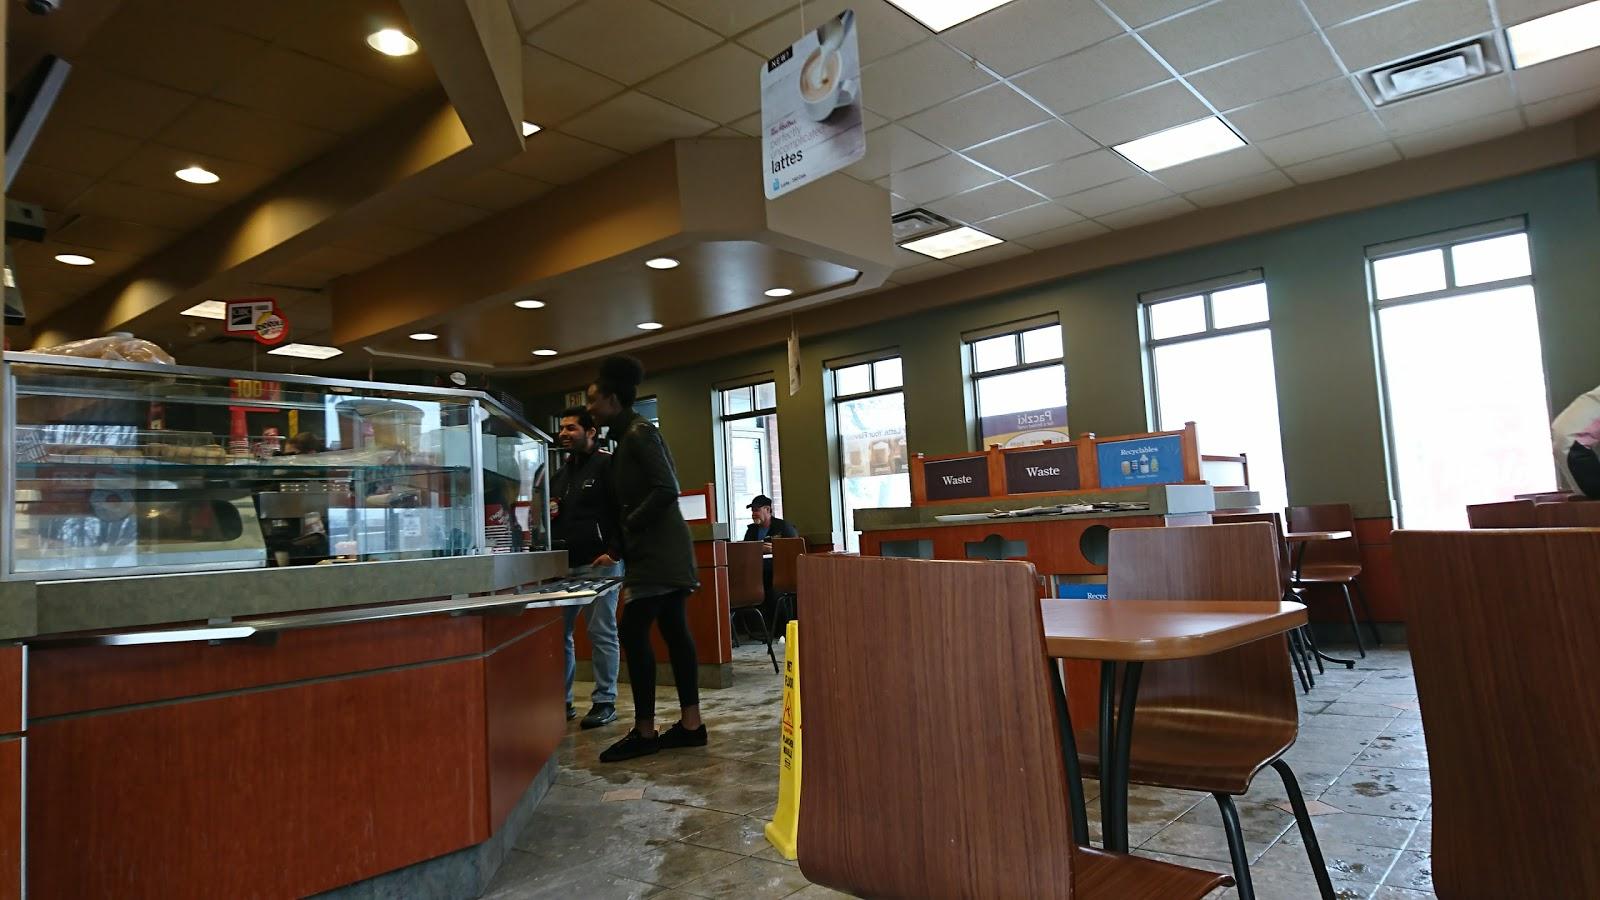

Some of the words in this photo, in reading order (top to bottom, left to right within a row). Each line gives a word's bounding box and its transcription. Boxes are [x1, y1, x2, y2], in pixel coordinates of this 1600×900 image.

[771, 51, 790, 67] NEW!
[771, 150, 803, 174] lattes
[1120, 446, 1159, 456] Recyclables
[1025, 466, 1061, 478] Waste
[942, 475, 973, 486] Waste
[1086, 592, 1107, 600] Recyc
